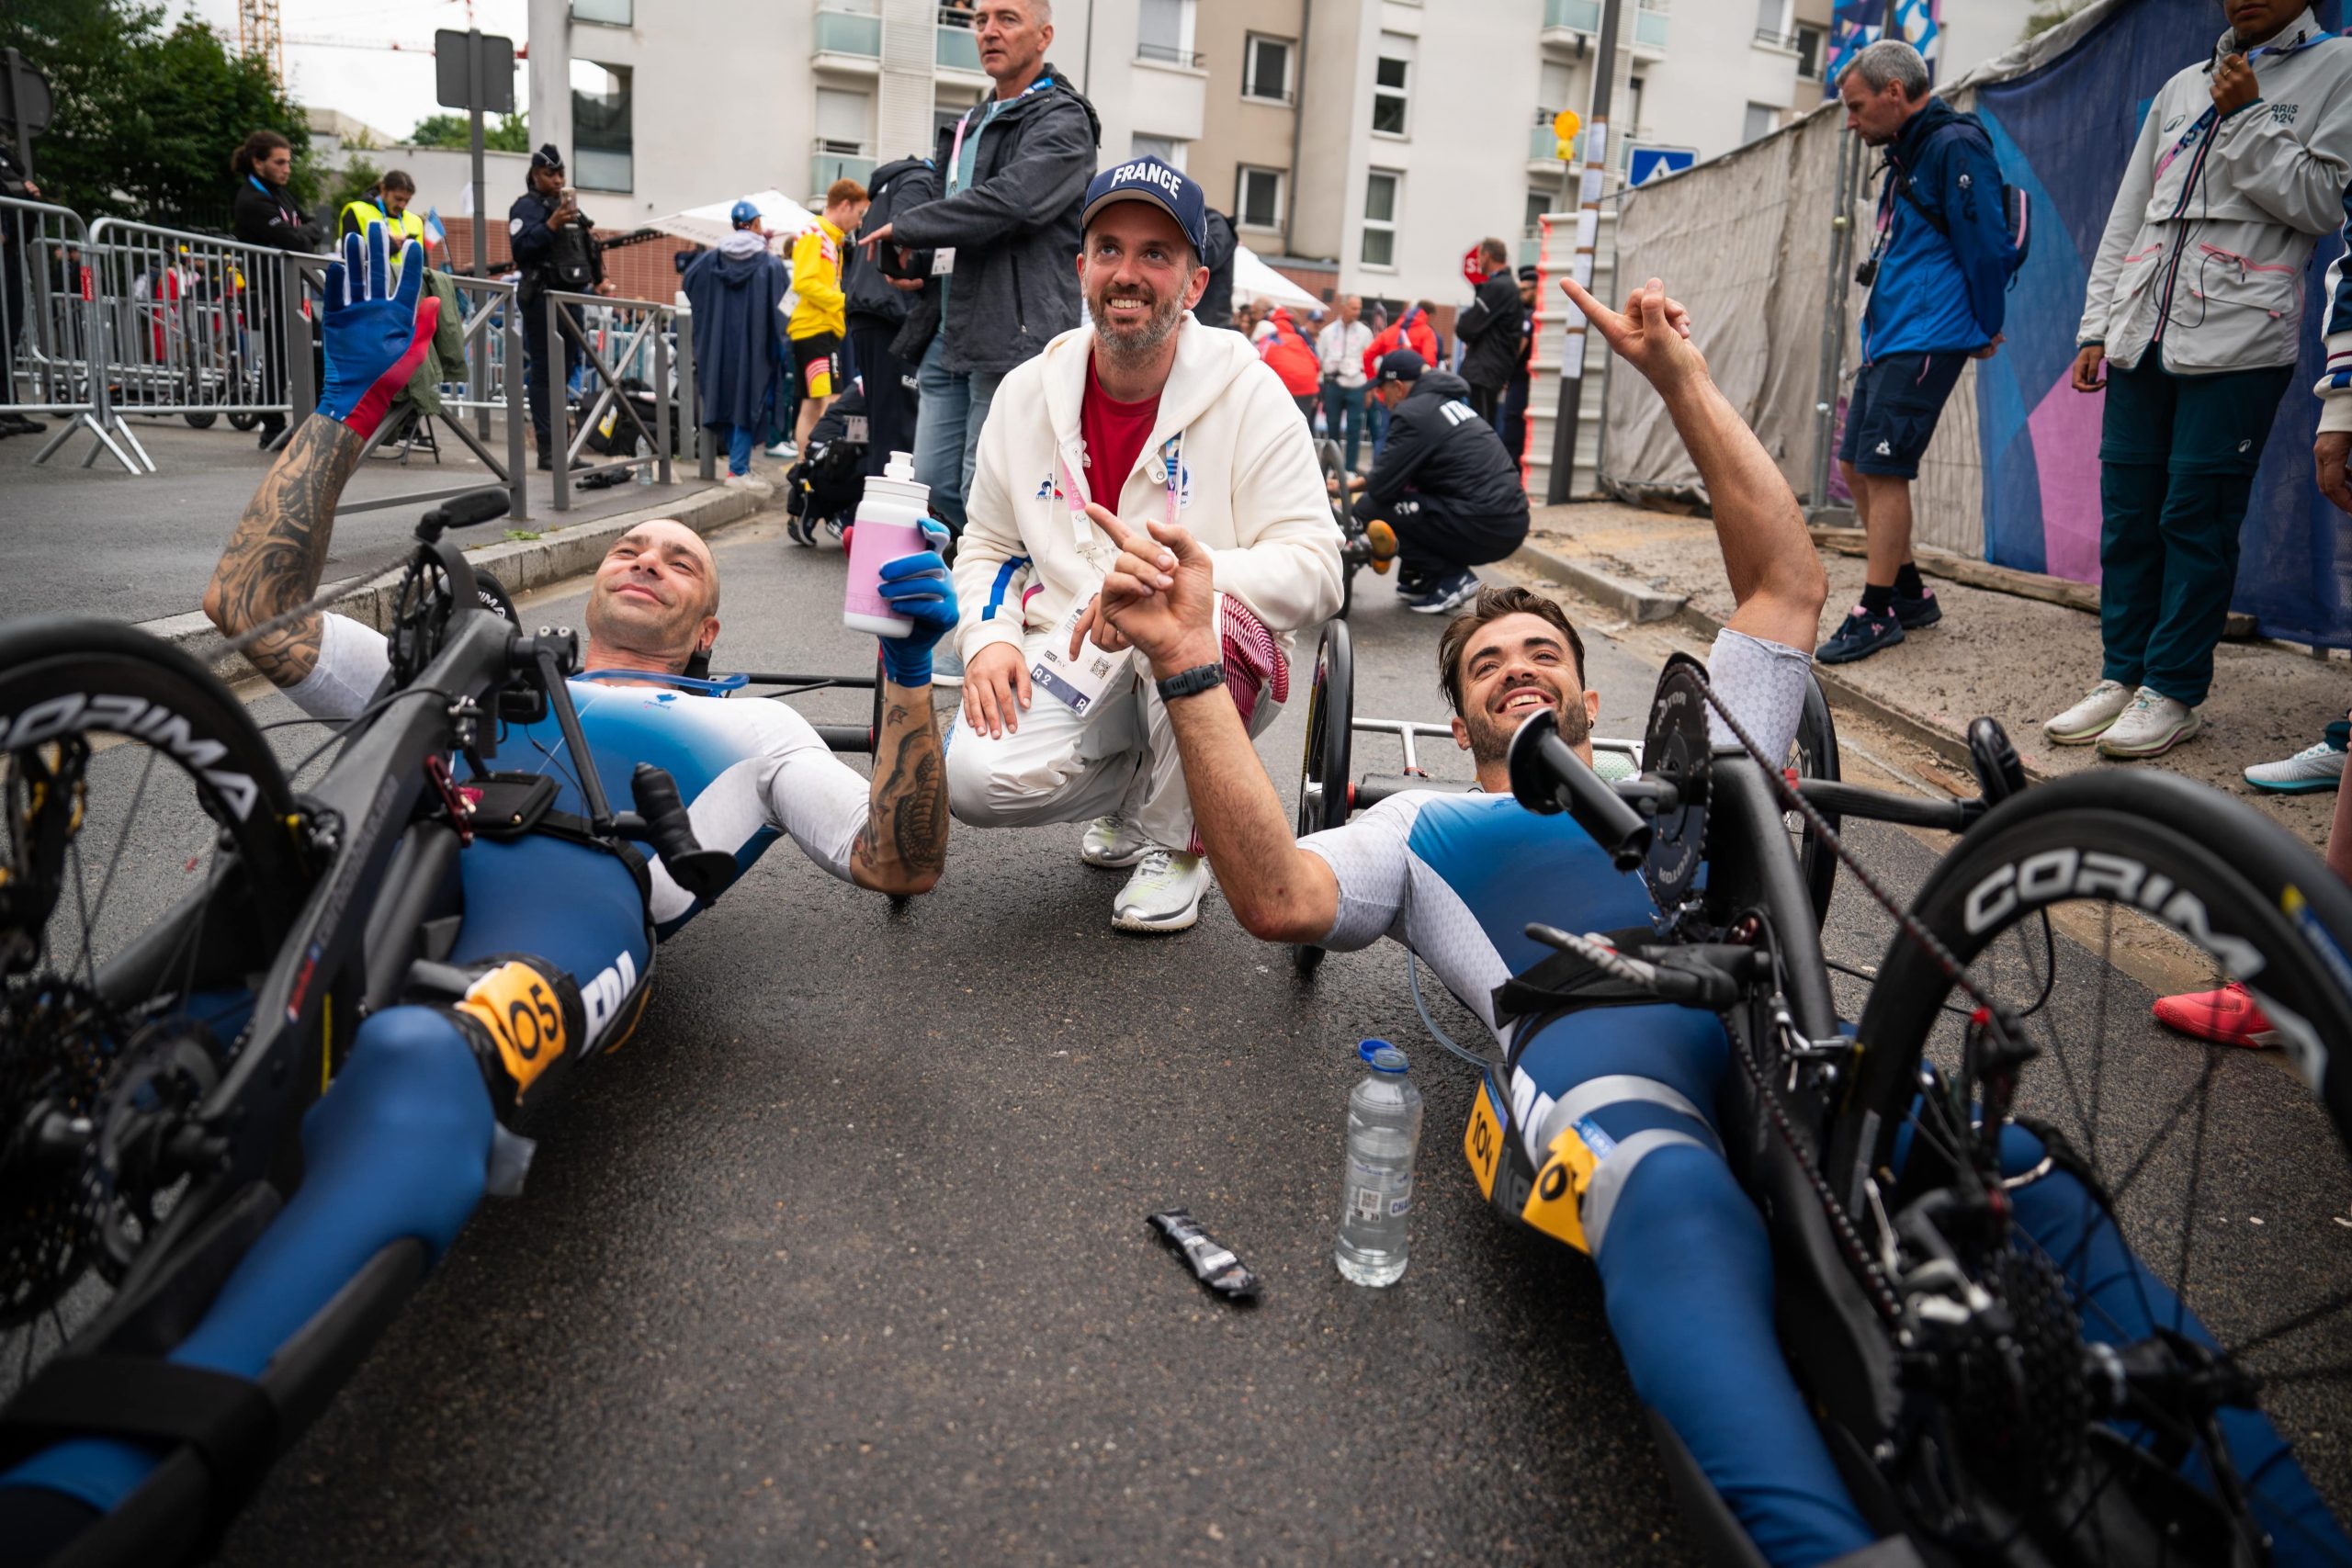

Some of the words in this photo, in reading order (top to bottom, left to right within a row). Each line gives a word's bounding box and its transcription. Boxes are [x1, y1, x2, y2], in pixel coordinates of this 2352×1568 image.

[2272, 104, 2299, 114] ARIS
[1111, 162, 1182, 200] FRANCE
[477, 591, 506, 618] IMA
[1033, 668, 1044, 679] A
[1042, 674, 1051, 685] 2
[1076, 698, 1086, 710] R
[0, 692, 259, 823] ORIMA
[1964, 847, 2329, 1097] CORIMA
[1473, 1111, 1493, 1177] 104
